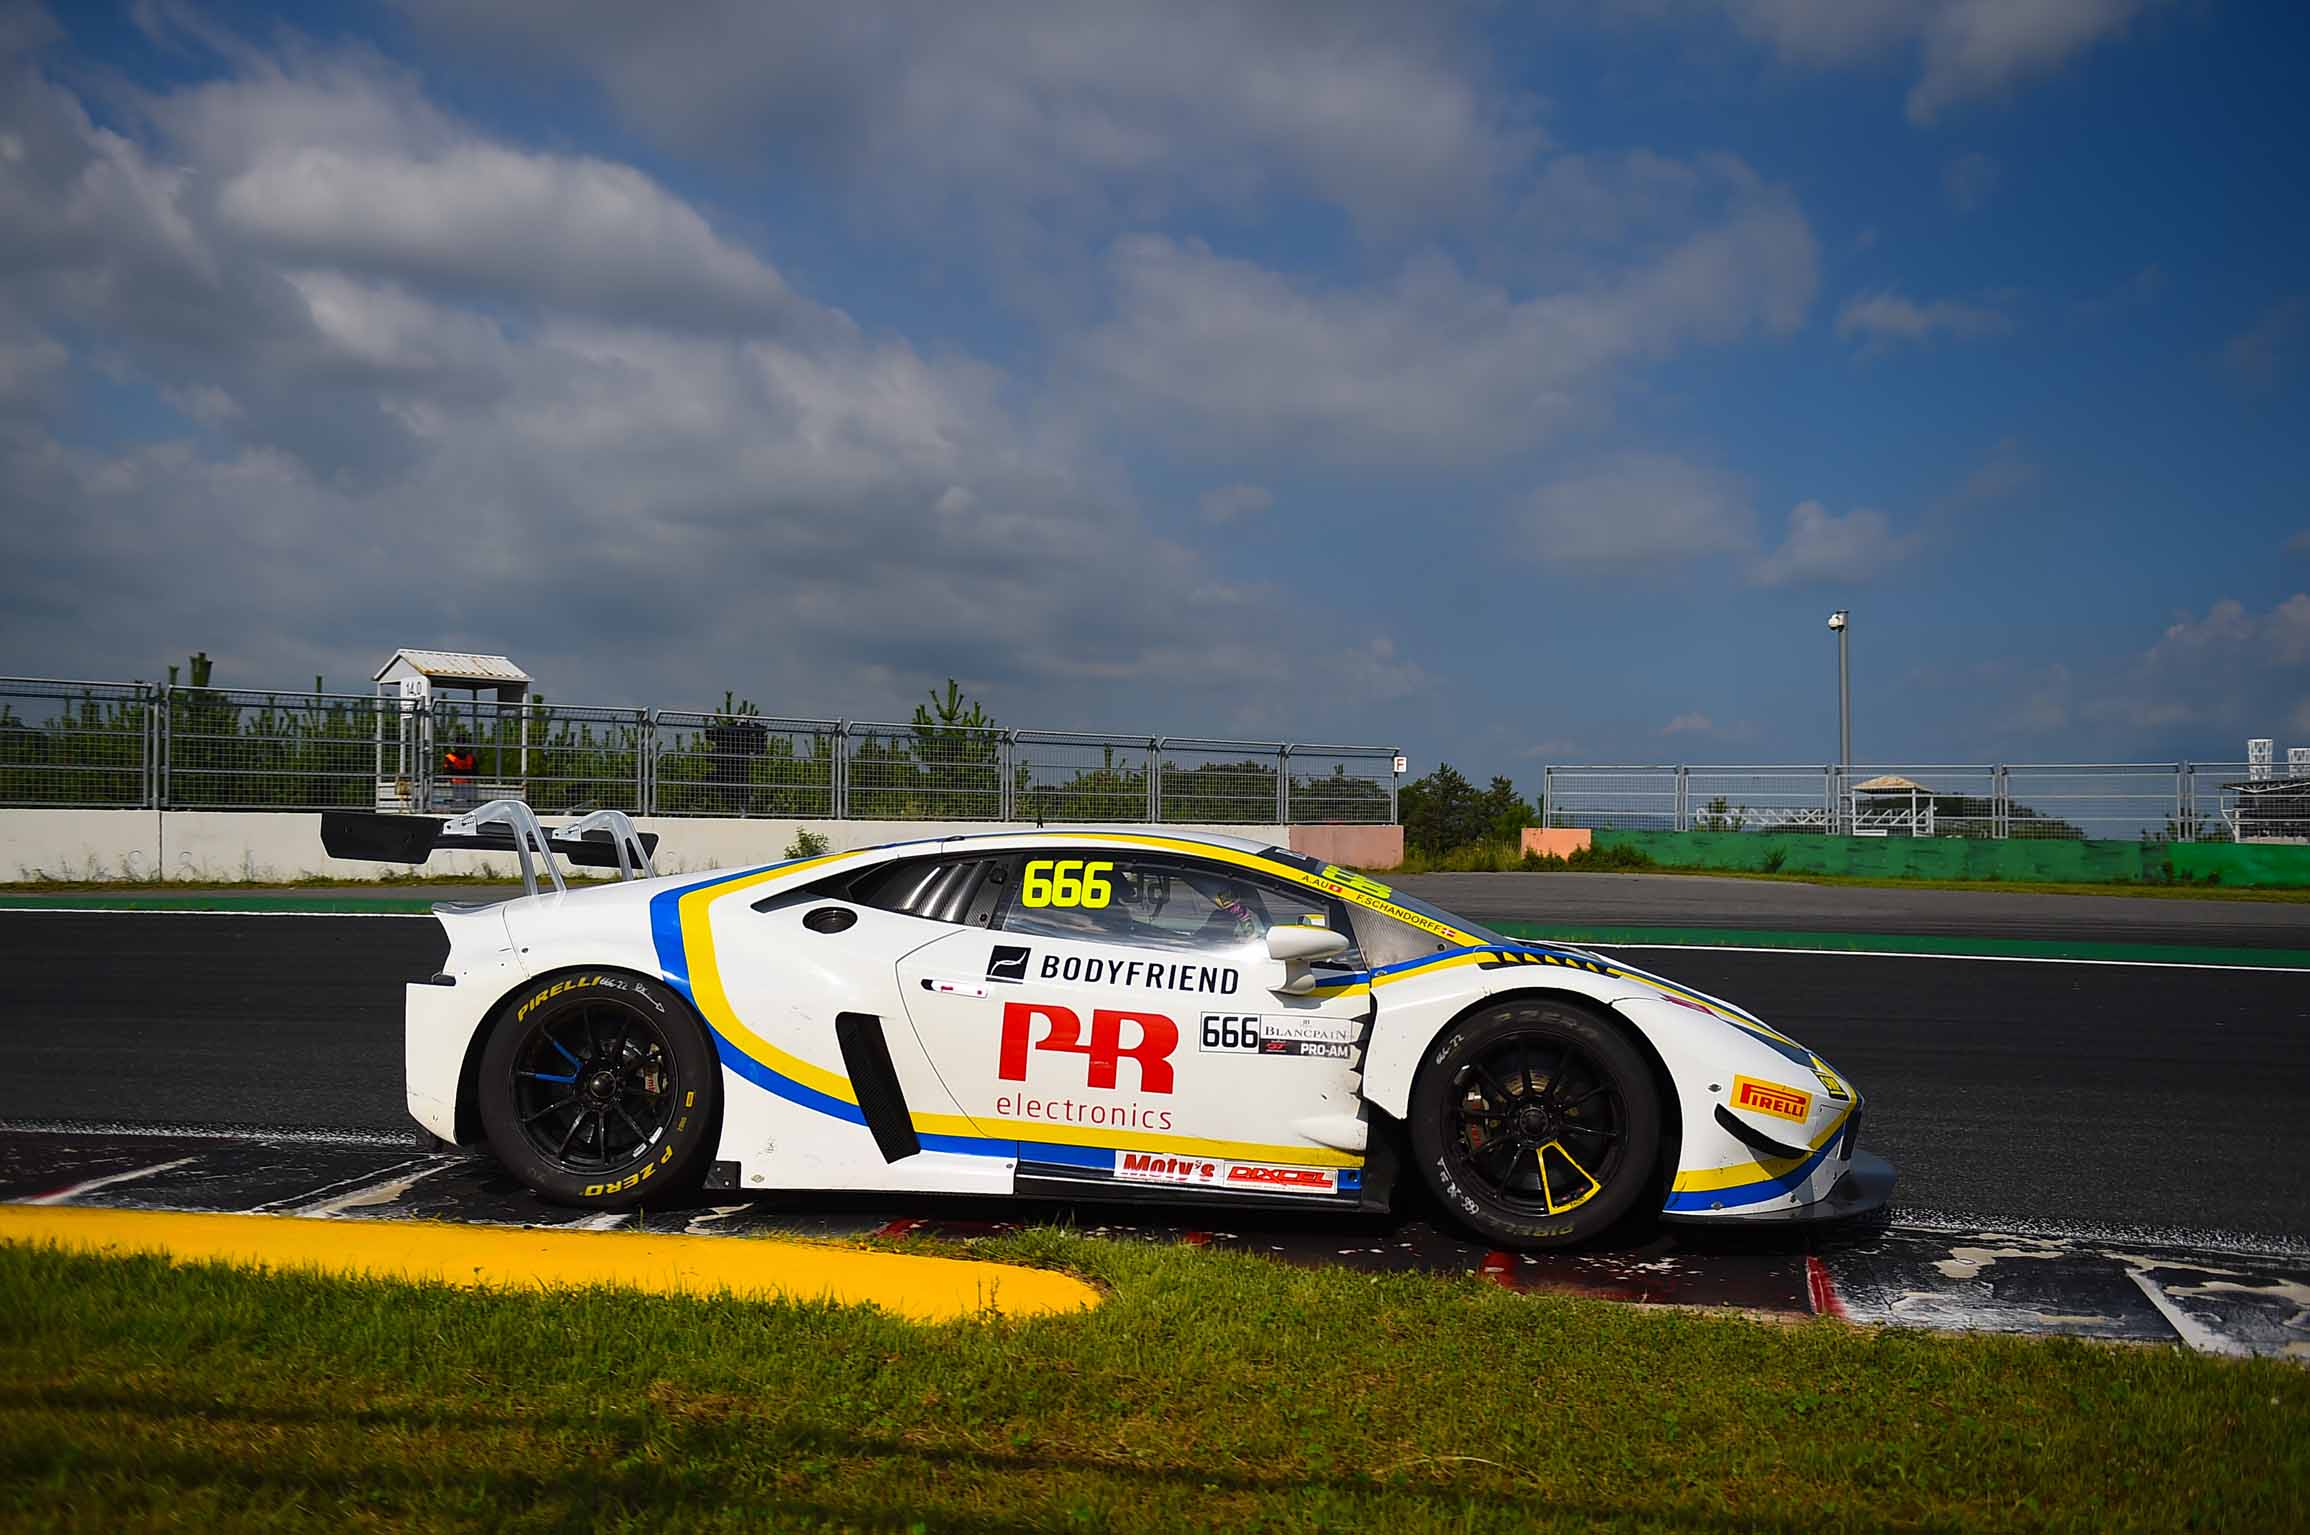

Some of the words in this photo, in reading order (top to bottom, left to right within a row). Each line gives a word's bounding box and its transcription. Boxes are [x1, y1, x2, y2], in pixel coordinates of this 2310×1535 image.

[1396, 758, 1405, 771] F
[1021, 859, 1114, 909] 666
[1301, 874, 1329, 889] A.AU
[1355, 893, 1441, 933] F.SCHANDORFF
[1040, 954, 1239, 995] BODYFRIEND
[517, 975, 602, 1023] PIRELLI
[998, 1001, 1179, 1095] PR
[1202, 1015, 1259, 1049] 666
[1265, 1025, 1347, 1041] BLANCPAIN
[1300, 1042, 1348, 1058] PRO-AM
[996, 1092, 1172, 1130] electronics
[1739, 1082, 1807, 1118] PIRELLI
[584, 1163, 656, 1197] ZERO
[1123, 1153, 1216, 1178] Moty's
[1226, 1165, 1334, 1189] DIXCEL
